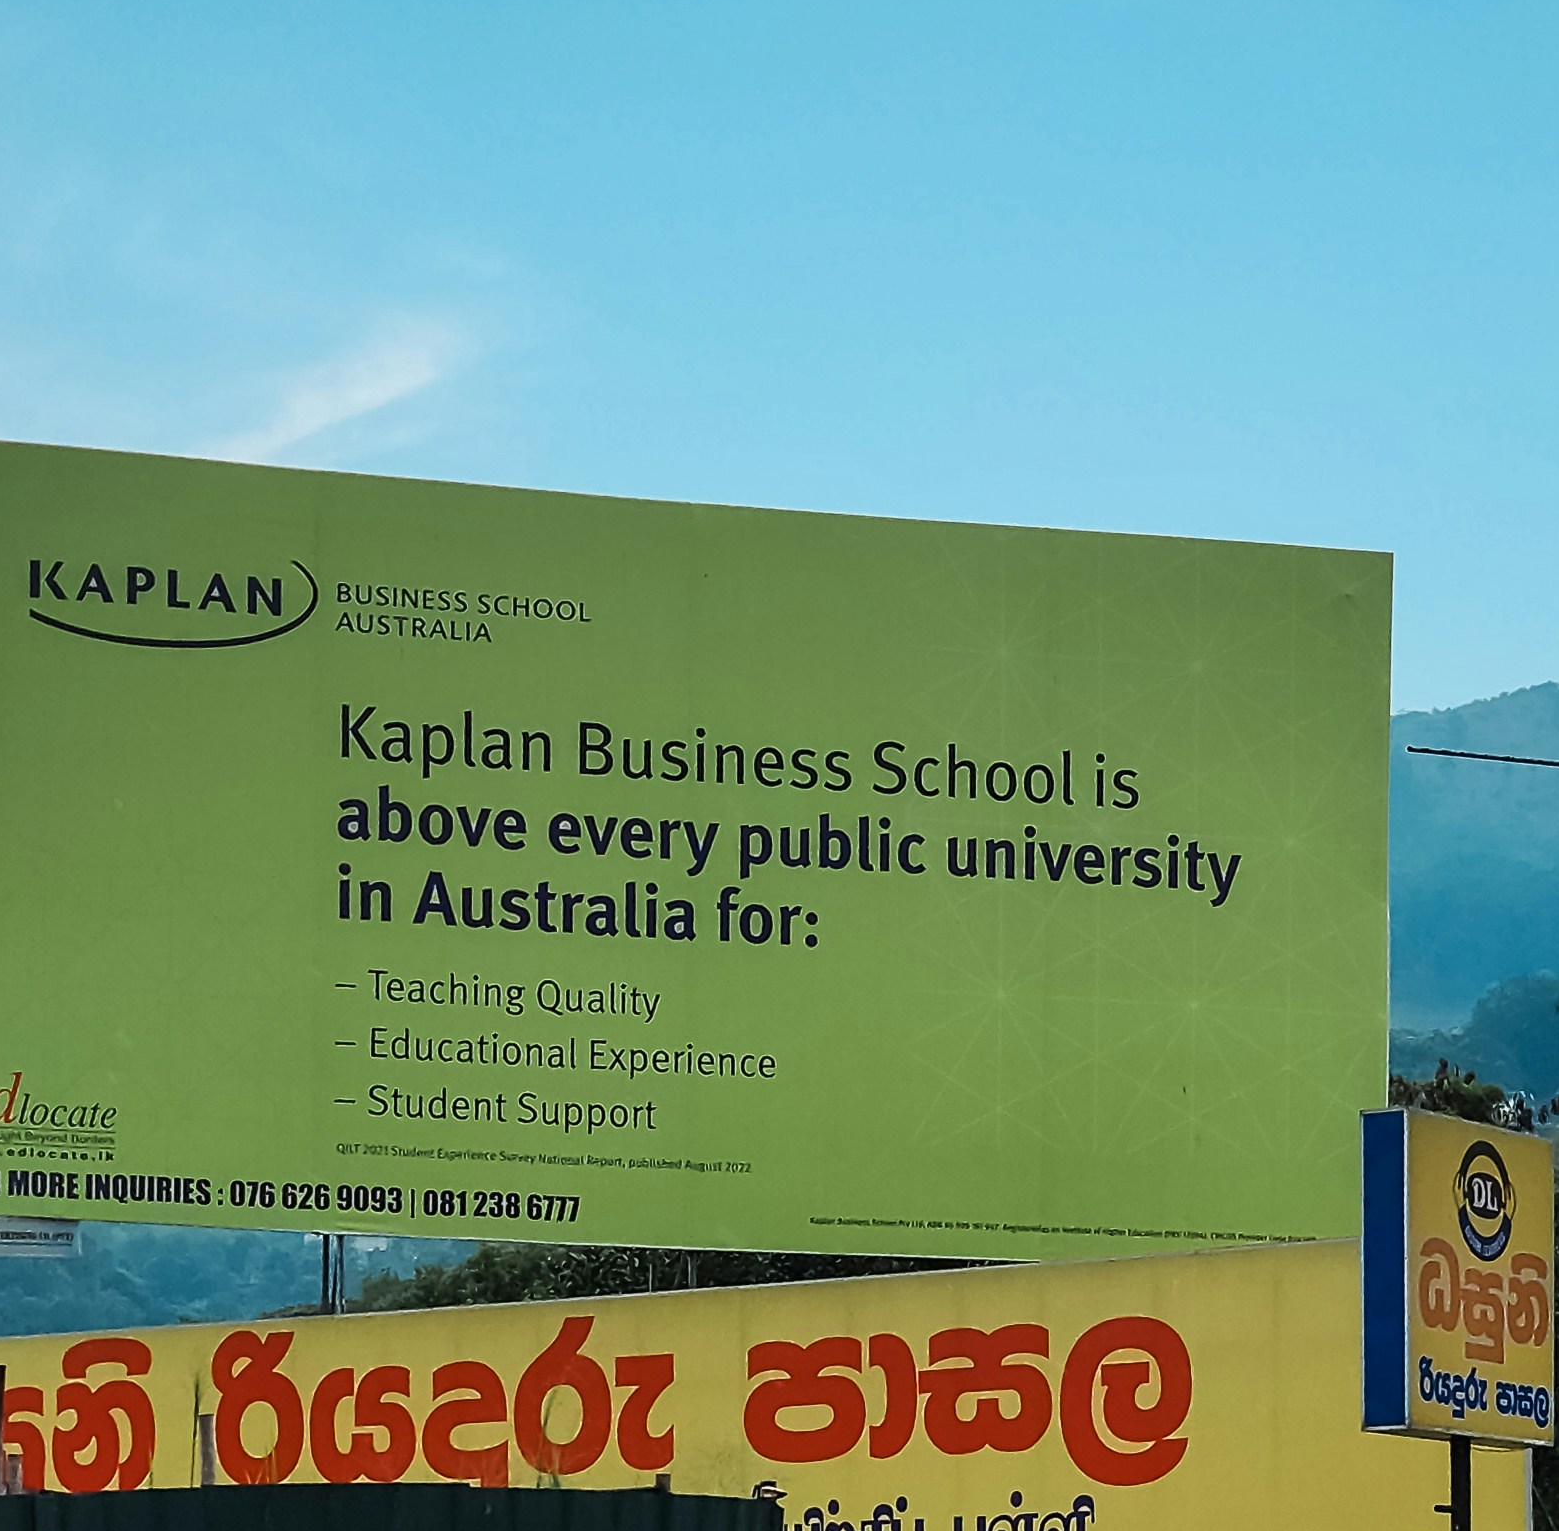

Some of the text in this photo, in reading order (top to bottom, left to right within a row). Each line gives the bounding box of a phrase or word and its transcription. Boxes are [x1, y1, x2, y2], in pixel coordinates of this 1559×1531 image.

[28, 558, 284, 617] KAPLAN
[336, 582, 592, 623] BUSINESS SCHOOL
[334, 611, 493, 644] AUSTRALIA
[340, 703, 1139, 810] Kaplan Business School is
[337, 784, 1242, 908] above every public university
[338, 862, 819, 949] in Australia for:
[367, 968, 526, 1016] Teaching
[536, 979, 661, 1024] Quality
[370, 1027, 577, 1070] Educational
[590, 1039, 776, 1080] Experience
[367, 1084, 508, 1123] Student
[517, 1092, 658, 1135] Support
[436, 1148, 497, 1162] Experience
[499, 1150, 536, 1165] Survey
[6, 1169, 80, 1200] MORE
[84, 1173, 212, 1206] INQUIRIES
[229, 1180, 276, 1209] 076
[281, 1182, 331, 1211] 626
[336, 1184, 403, 1214] 9093
[422, 1189, 468, 1217] 081
[472, 1190, 521, 1219] 238
[526, 1193, 581, 1223] 6777
[1471, 1177, 1499, 1212] DL
[744, 1317, 1192, 1486] පාසල
